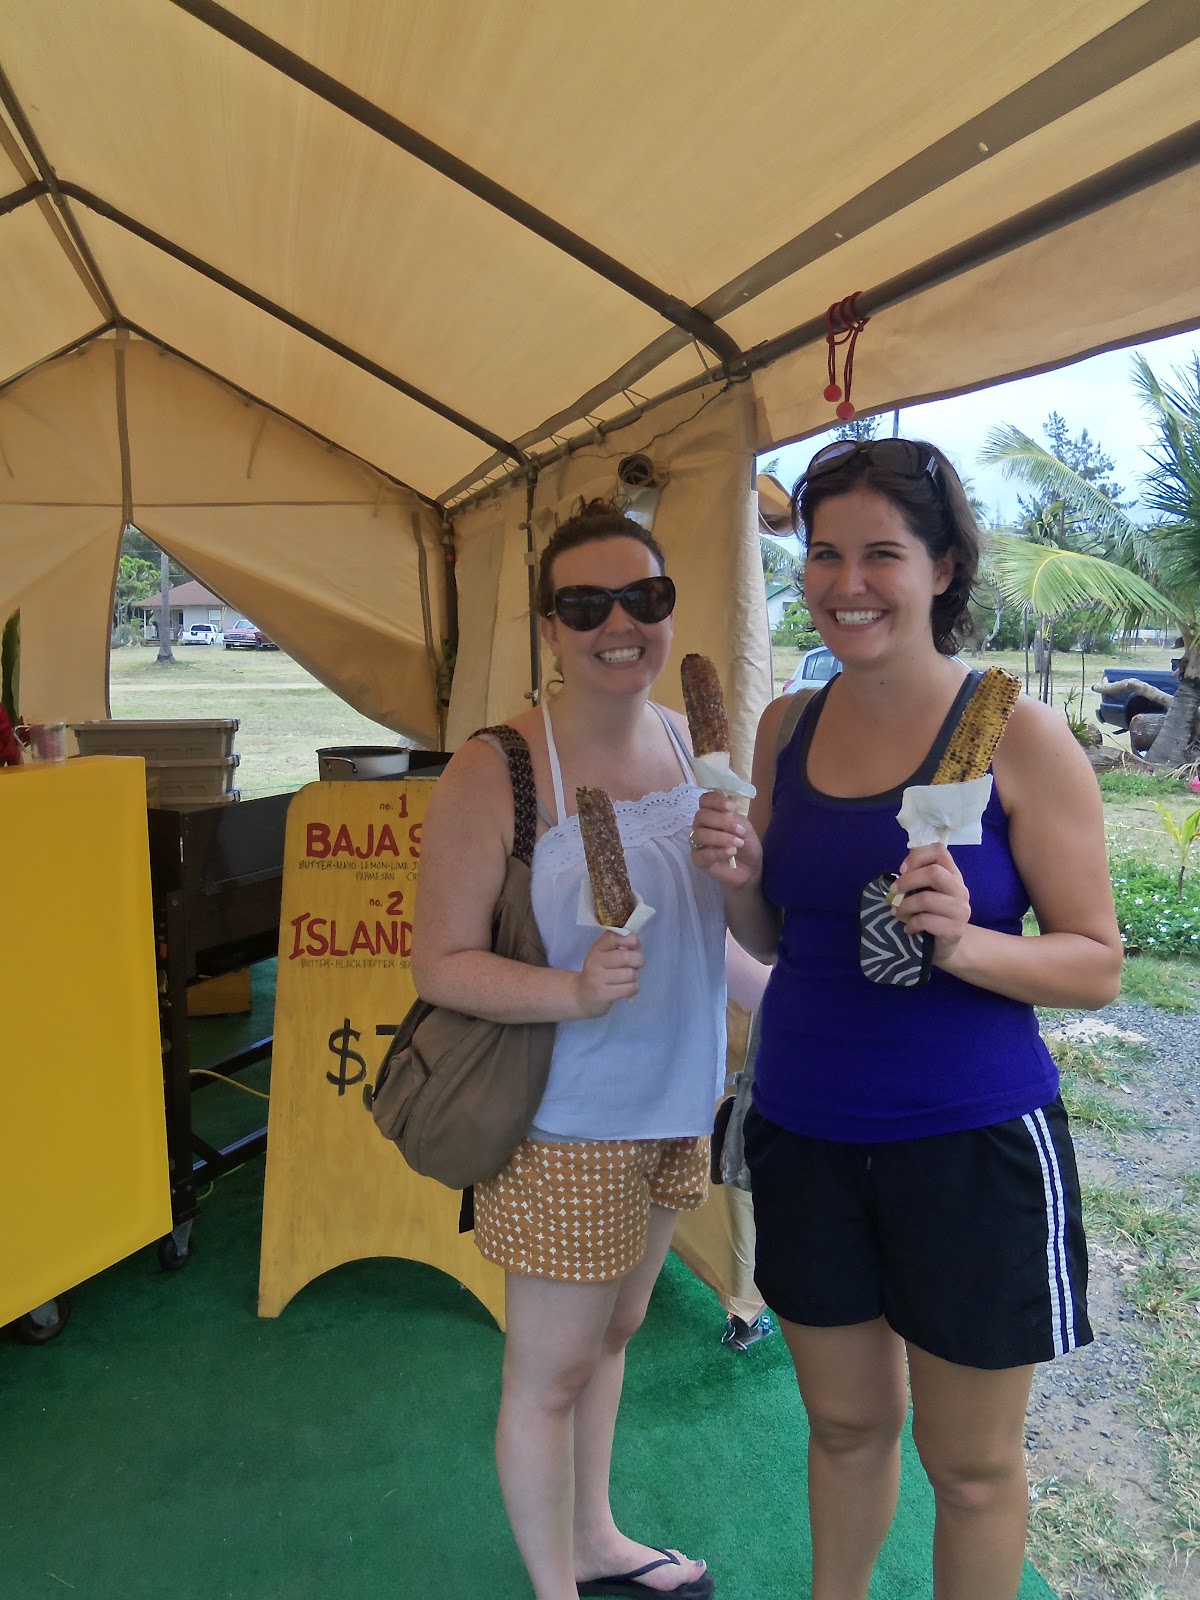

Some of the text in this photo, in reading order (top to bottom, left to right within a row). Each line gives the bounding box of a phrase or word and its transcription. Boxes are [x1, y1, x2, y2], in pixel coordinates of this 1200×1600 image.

[379, 794, 409, 818] no. 1
[306, 823, 399, 859] BAJA
[356, 871, 395, 881] PARMESAN
[370, 890, 404, 916] no. 2
[289, 912, 413, 960] ISLAND
[301, 958, 330, 969] BUTTER
[336, 959, 361, 969] BLACK
[364, 959, 395, 969] PEPPER
